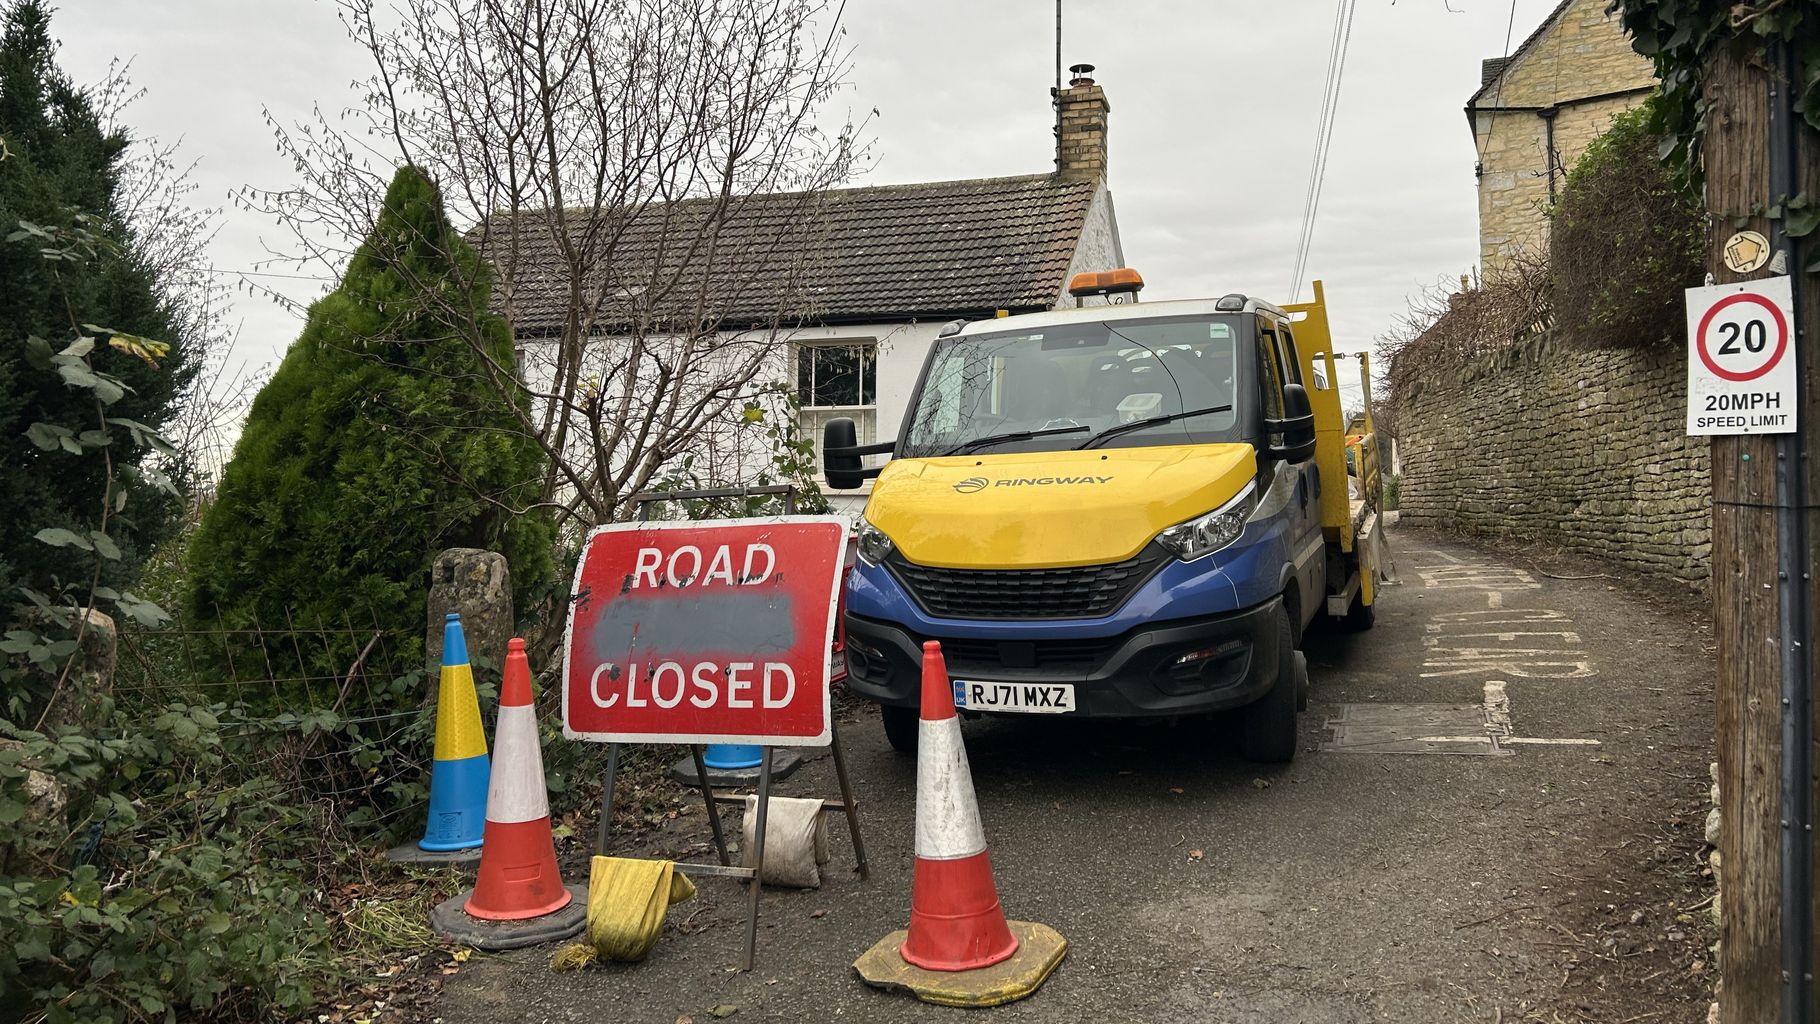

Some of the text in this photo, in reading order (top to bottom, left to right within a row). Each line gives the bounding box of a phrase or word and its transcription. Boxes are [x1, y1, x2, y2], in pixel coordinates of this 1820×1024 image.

[1718, 319, 1767, 356] 20
[1705, 392, 1780, 412] 20MPH
[1697, 414, 1788, 428] SPEED LIMIT
[994, 476, 1114, 487] RINGWAY
[631, 543, 776, 588] ROAD
[1414, 563, 1600, 679] KEEP CLEAR
[590, 661, 796, 709] CLOSED
[971, 684, 1067, 707] RJ71 MXZ
